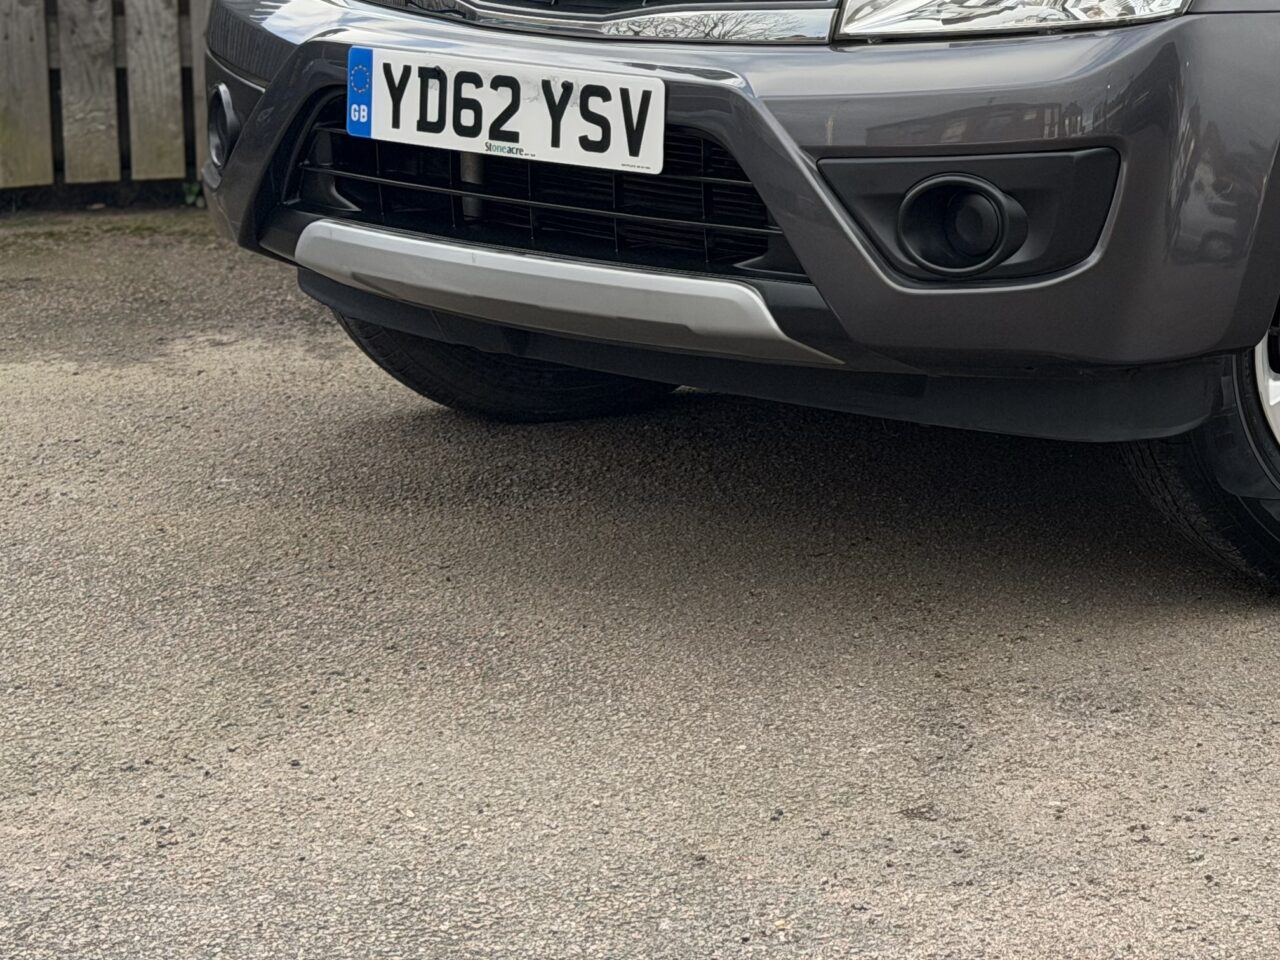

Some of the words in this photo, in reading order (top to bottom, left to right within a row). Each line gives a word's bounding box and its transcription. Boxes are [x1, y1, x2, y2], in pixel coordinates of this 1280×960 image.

[350, 103, 369, 123] GB
[382, 62, 521, 145] YD62
[541, 78, 653, 158] YSV
[484, 141, 525, 157] Stoneacre
